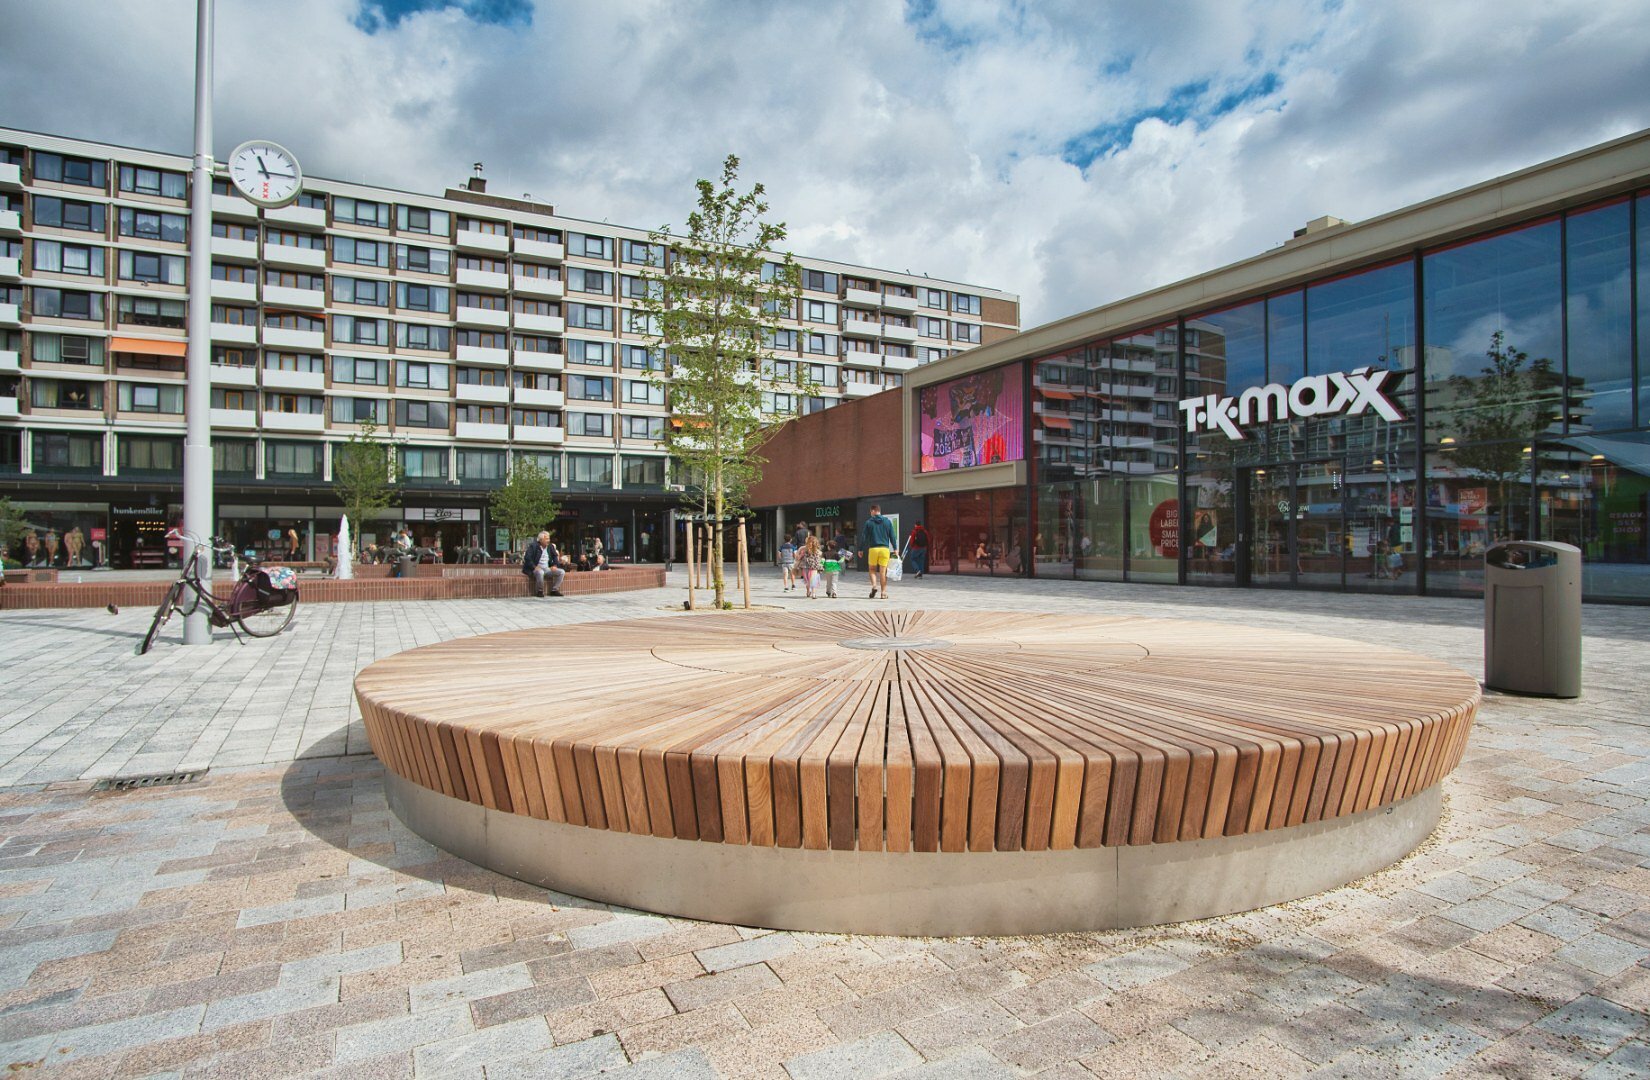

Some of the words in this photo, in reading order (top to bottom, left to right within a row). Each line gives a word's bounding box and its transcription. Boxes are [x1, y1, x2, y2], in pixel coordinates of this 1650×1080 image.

[815, 505, 840, 518] DOUGLAS
[1166, 509, 1178, 518] BIG
[674, 513, 733, 521] SKCHES
[1161, 530, 1179, 539] SMAL
